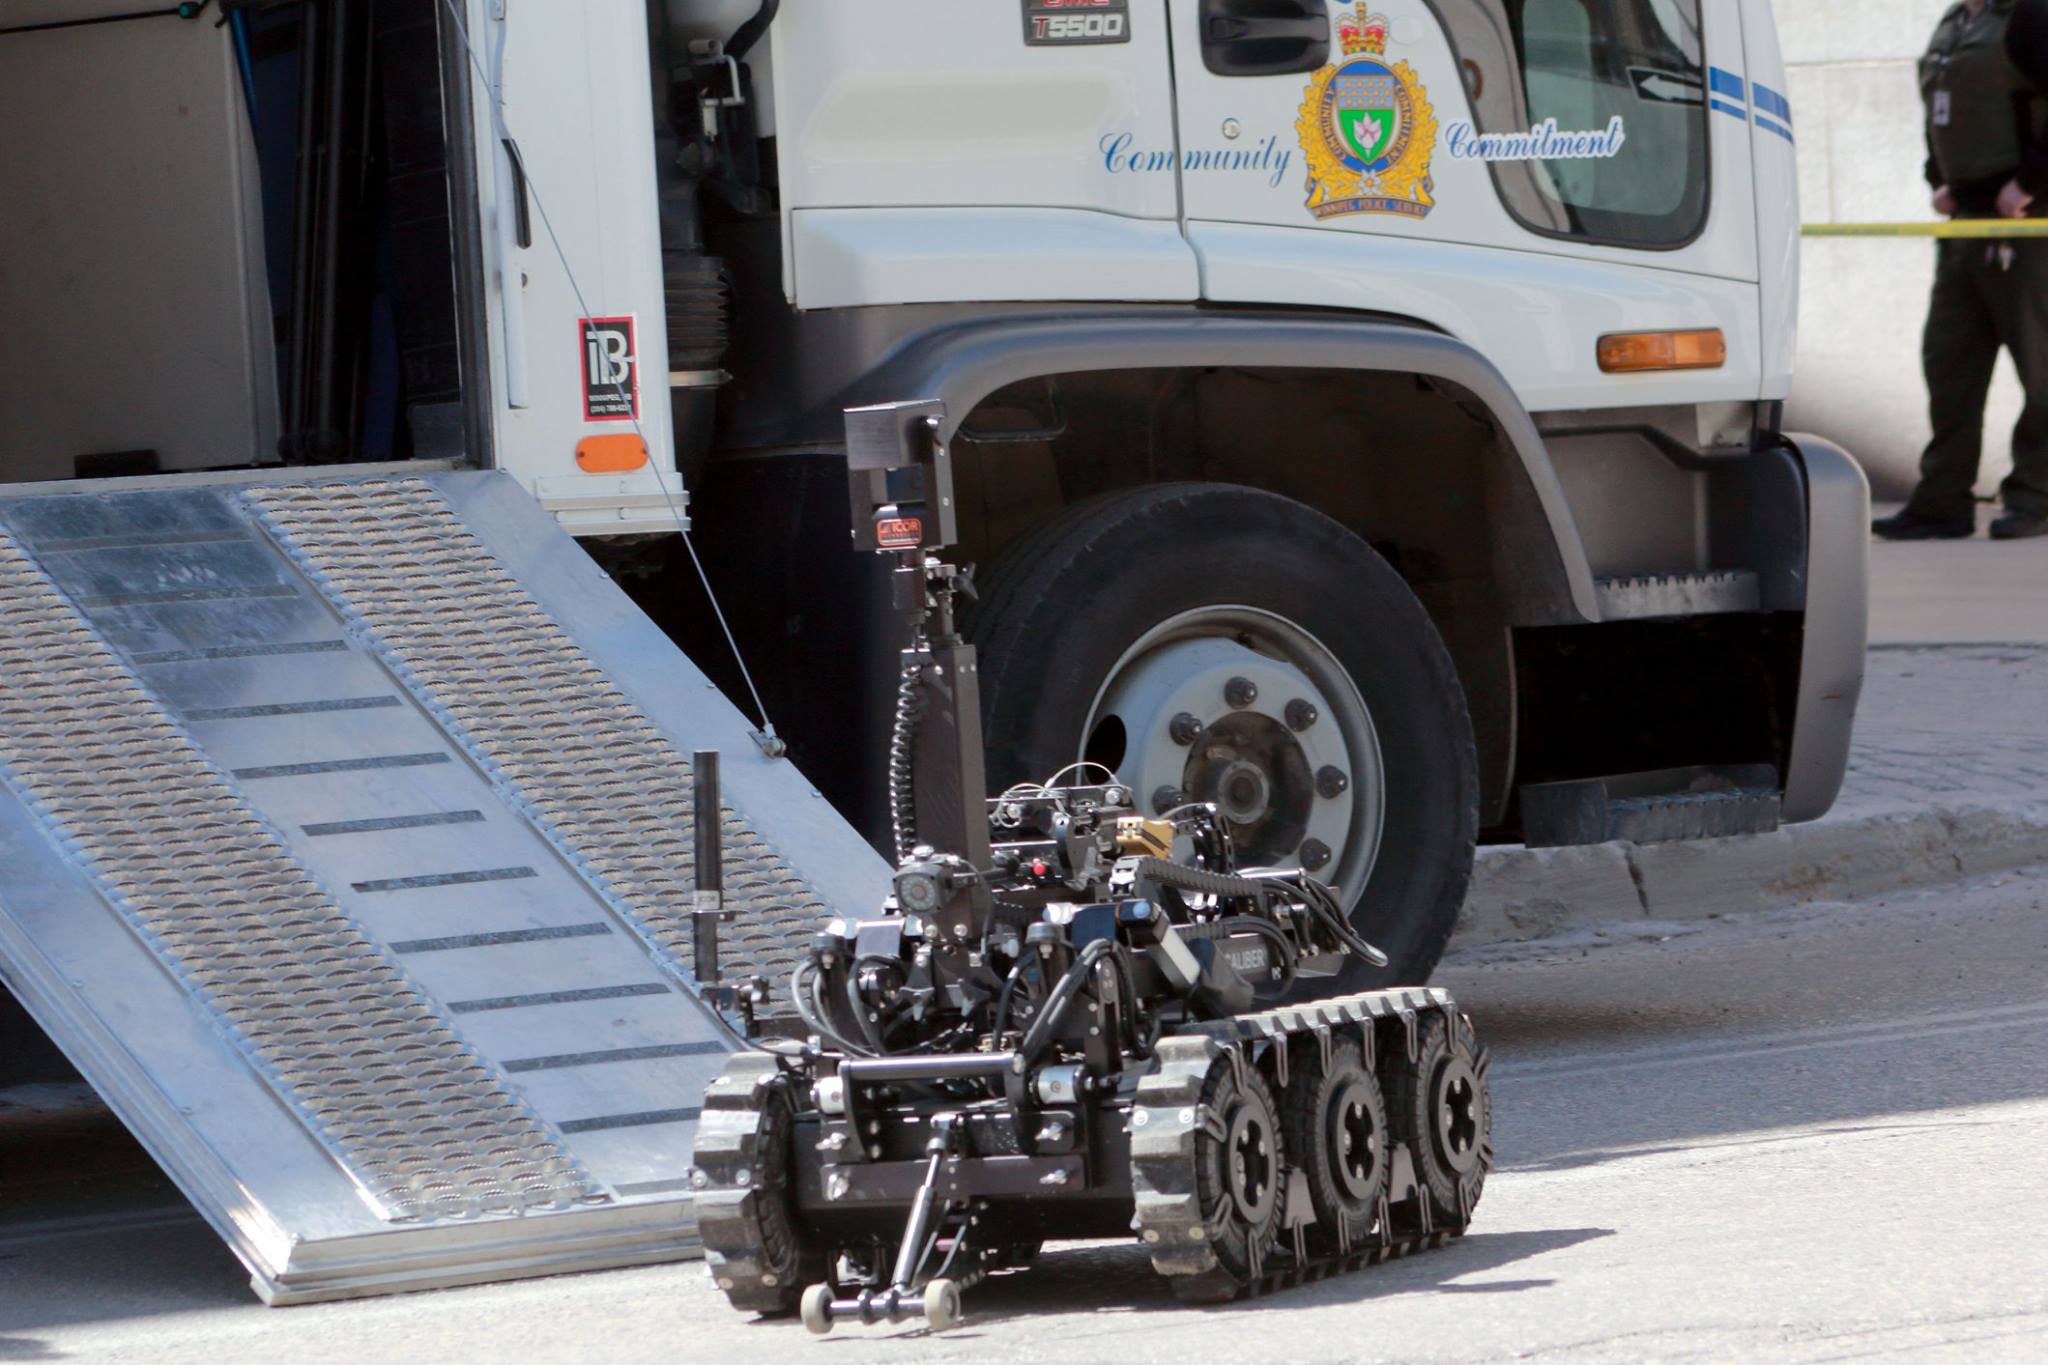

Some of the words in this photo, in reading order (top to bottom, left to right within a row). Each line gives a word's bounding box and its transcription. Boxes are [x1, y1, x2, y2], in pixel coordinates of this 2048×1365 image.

[1031, 14, 1123, 39] T5500
[1099, 132, 1291, 188] Community
[1444, 118, 1622, 160] Commitment
